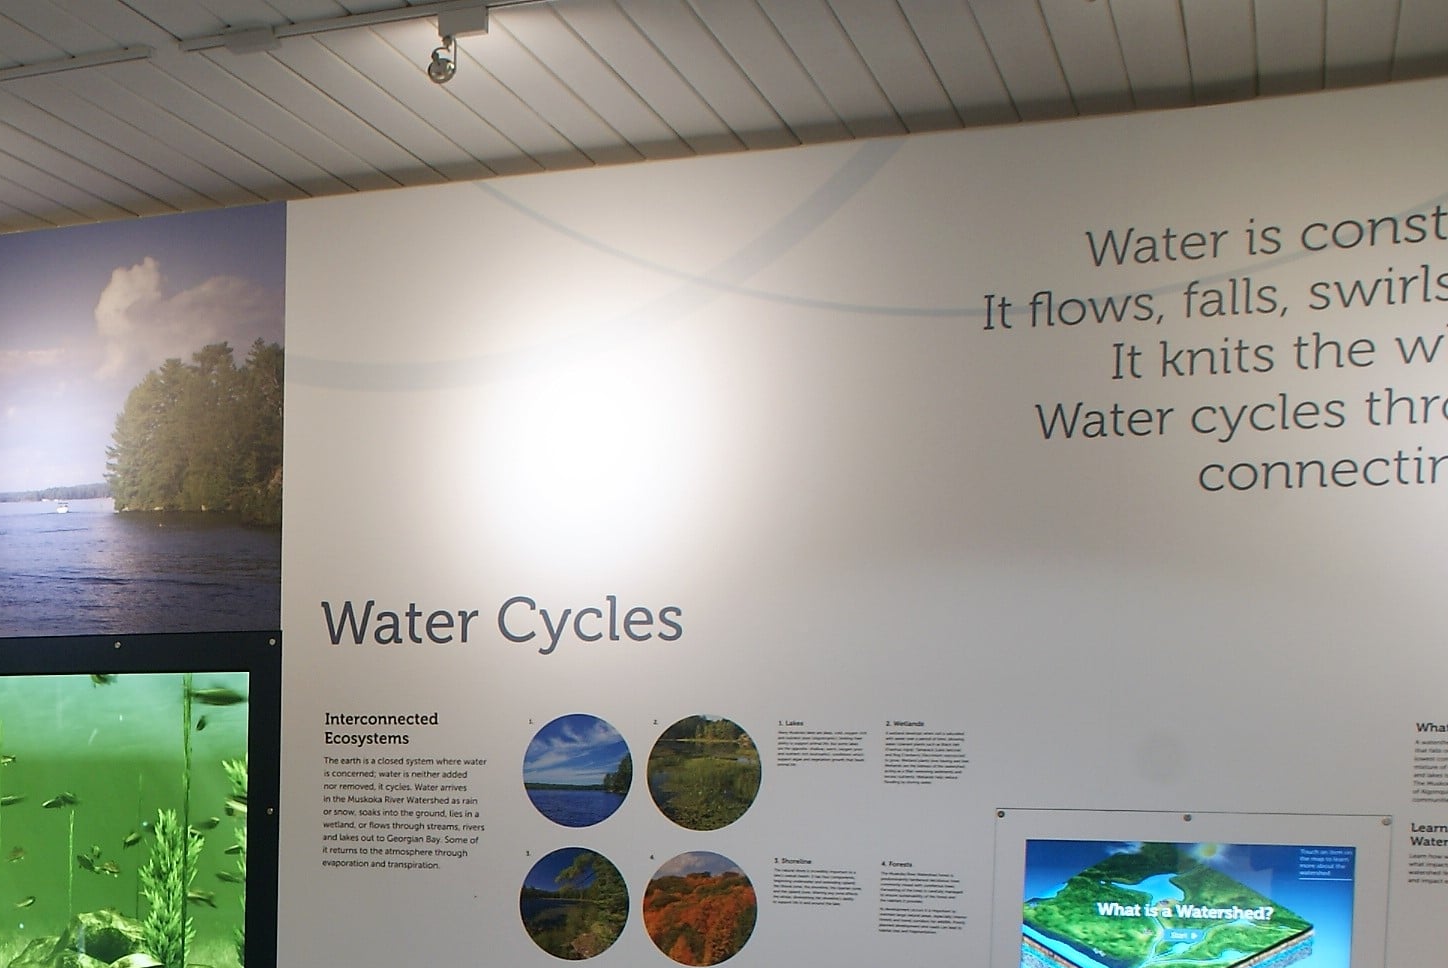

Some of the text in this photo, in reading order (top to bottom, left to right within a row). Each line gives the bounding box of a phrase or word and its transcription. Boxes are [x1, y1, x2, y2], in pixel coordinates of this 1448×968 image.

[1085, 205, 1448, 267] Water is const
[983, 294, 1012, 330] It
[1029, 290, 1164, 328] flows,
[1183, 277, 1289, 318] falls,
[1112, 325, 1448, 380] It knits the w
[1035, 387, 1448, 443] Water cycles thr
[321, 595, 684, 656] Water Cycles
[324, 712, 439, 726] Interconnected
[324, 731, 410, 747] Ecosystems
[323, 756, 339, 764] The
[341, 757, 362, 765] earth
[363, 757, 370, 765] is
[377, 757, 404, 765] closed
[406, 758, 434, 767] system
[436, 757, 462, 765] where
[463, 758, 488, 766] water
[378, 770, 402, 778] water
[403, 770, 410, 778] is
[411, 770, 440, 778] neither
[442, 770, 468, 779] added
[414, 783, 439, 791] Water
[440, 784, 467, 792] arrives
[323, 795, 331, 803] in
[332, 795, 346, 803] the
[347, 795, 383, 804] Muskoka
[384, 795, 405, 804] River
[406, 796, 450, 805] Watershed
[462, 797, 478, 805] rain
[359, 808, 381, 816] soaks
[382, 809, 399, 817] into
[400, 809, 414, 817] the
[464, 810, 473, 818] in
[369, 821, 391, 829] flows
[392, 822, 425, 832] through
[462, 823, 485, 831] rivers
[1411, 822, 1448, 833] Learn
[339, 833, 359, 842] lakes
[387, 834, 424, 845] Georgian
[444, 835, 468, 844] Some
[469, 836, 479, 844] of
[322, 846, 328, 854] it
[359, 847, 368, 855] to
[370, 847, 383, 855] the
[384, 848, 433, 857] atmosphere
[434, 848, 468, 859] through
[322, 860, 369, 868] evaporation
[370, 860, 386, 868] and
[1097, 902, 1275, 921] What is a Watershed?
